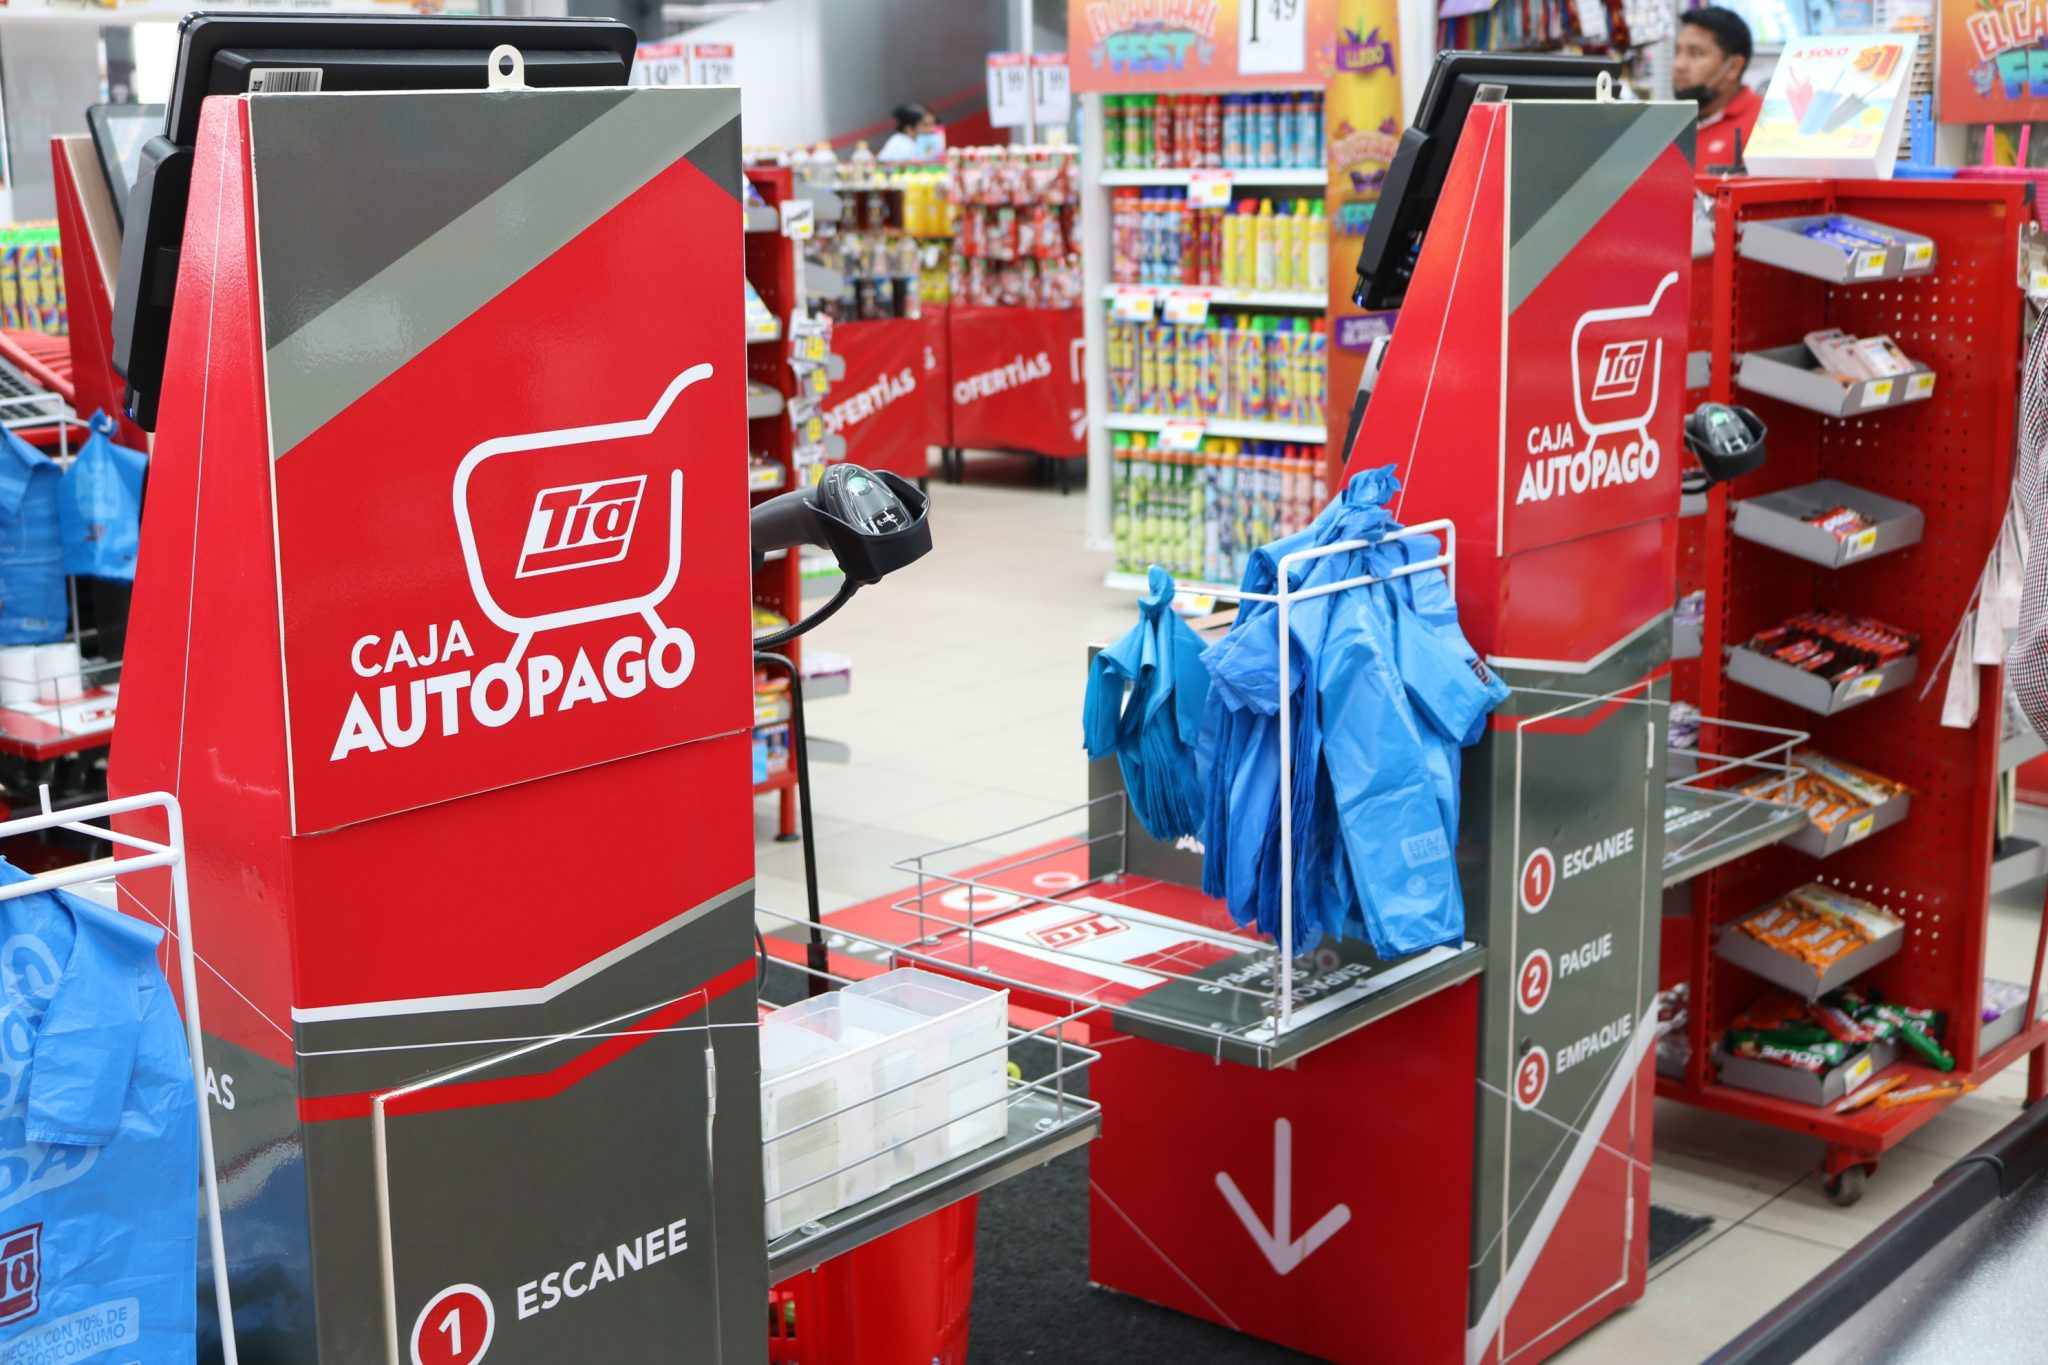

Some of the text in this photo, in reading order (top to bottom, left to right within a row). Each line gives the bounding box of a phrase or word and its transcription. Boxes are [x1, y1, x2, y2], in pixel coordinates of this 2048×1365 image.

[1106, 30, 1198, 74] FEST
[1792, 44, 1903, 82] A SOLO $1
[953, 352, 1052, 406] OFERTÍAS
[1527, 421, 1575, 455] CAJA
[1515, 438, 1661, 506] AUTOPAGO
[350, 619, 475, 678] CAJA
[329, 627, 696, 762] AUTOPAGO
[1531, 827, 1635, 896] 1 ESCANEE
[1262, 961, 1373, 1010] EMPAQ
[1527, 932, 1613, 999] 2 PAGUE
[1525, 1013, 1632, 1095] 3 EMPAQUE
[438, 1217, 689, 1357] 1 ESCANEE
[44, 1322, 73, 1346] CON
[75, 1312, 104, 1335] 70%
[106, 1305, 128, 1325] DE
